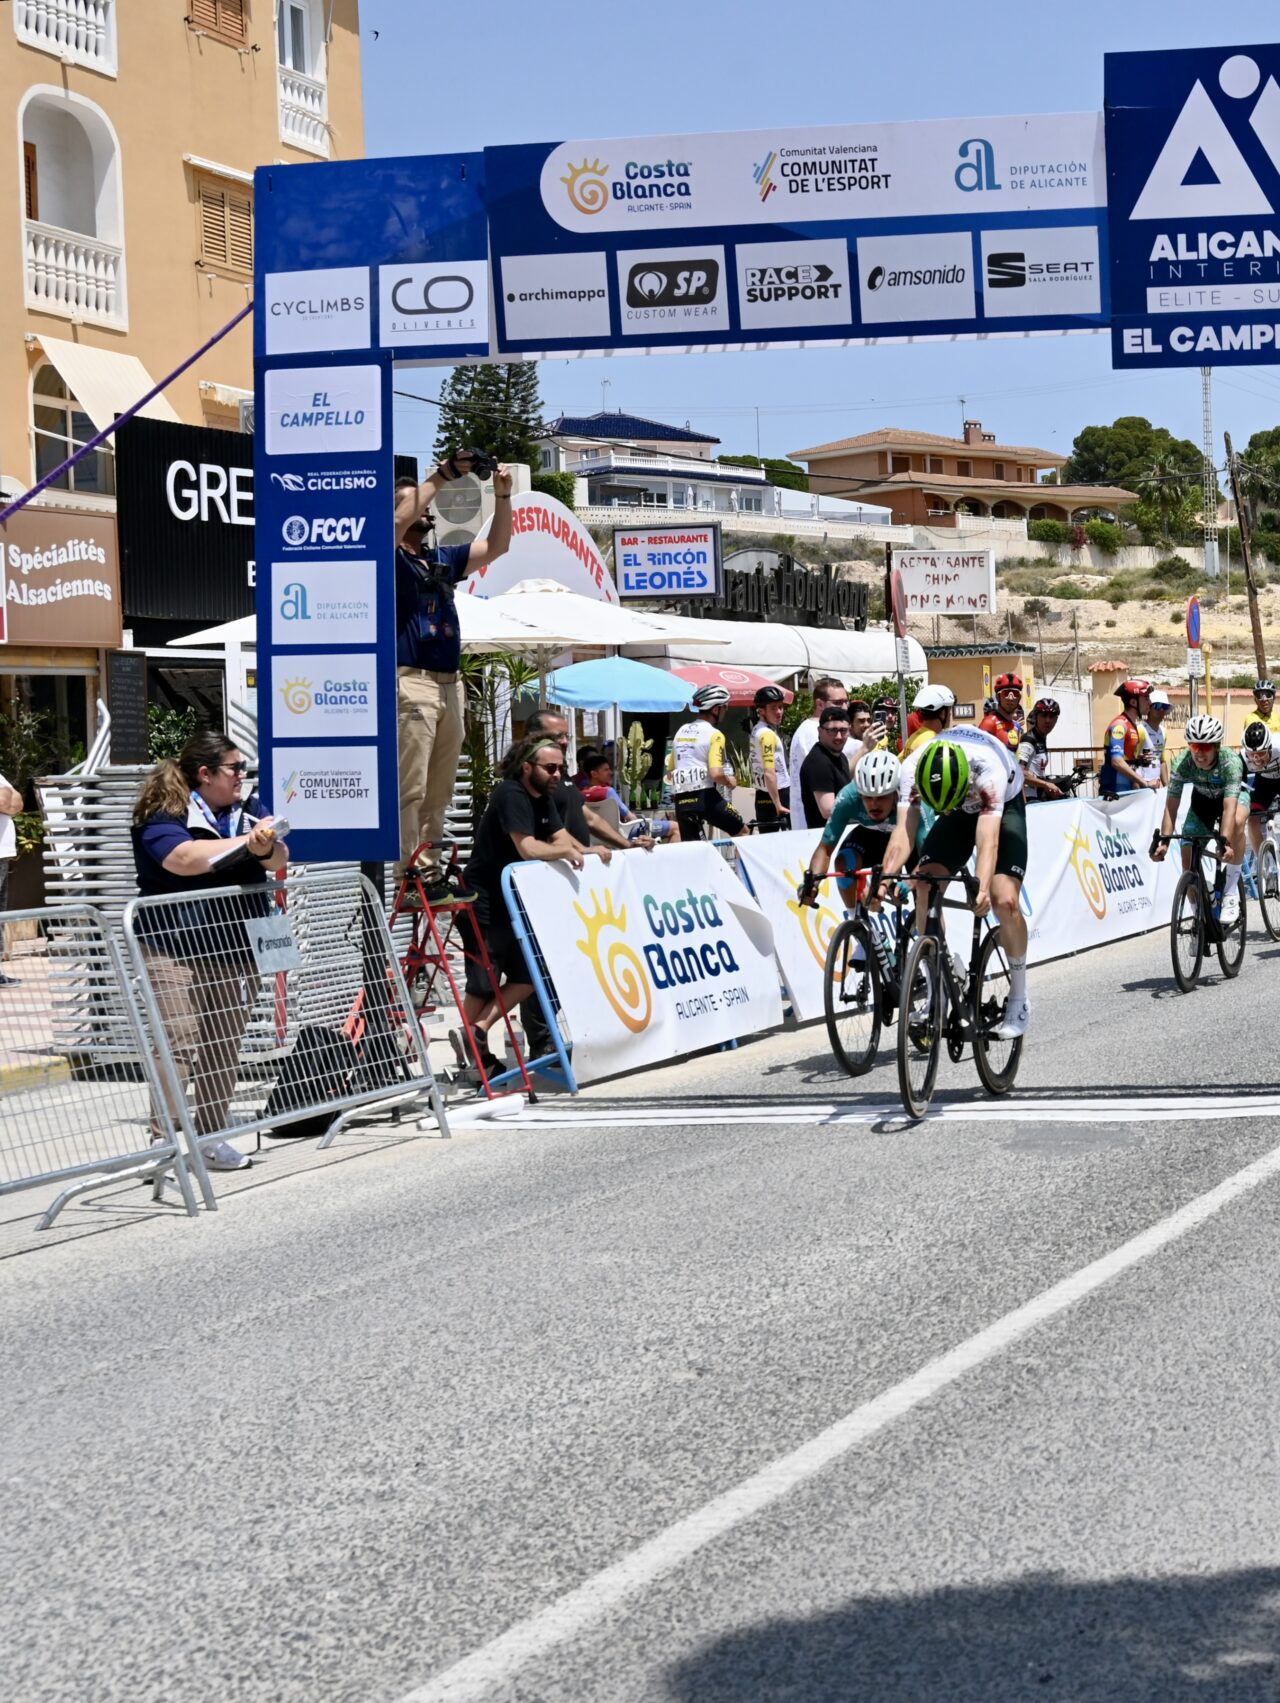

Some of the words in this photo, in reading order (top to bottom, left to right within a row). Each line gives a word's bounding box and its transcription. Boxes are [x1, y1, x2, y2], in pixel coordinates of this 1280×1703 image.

[780, 147, 826, 157] Comunitat
[828, 143, 878, 155] Valenciana
[625, 160, 690, 179] Costa
[780, 158, 878, 178] COMUNITAT
[1010, 161, 1088, 176] DIPUTACIÓN
[612, 180, 692, 200] Blanca
[788, 176, 811, 192] DE
[814, 173, 891, 191] L'ESPORT
[1010, 181, 1025, 190] DE
[1031, 177, 1088, 189] ALICANTE
[627, 204, 664, 213] ALICANTE
[667, 202, 692, 211] SPAIN
[745, 265, 813, 286] RACE
[887, 264, 966, 288] amsonido
[1028, 261, 1095, 275] SEAT
[519, 285, 606, 303] archimappa
[746, 284, 842, 303] SUPPORT
[1160, 291, 1223, 307] ELITE
[271, 297, 365, 316] CYCLIMBS
[626, 308, 678, 320] CUSTOM
[684, 306, 718, 317] WEAR
[392, 319, 475, 331] OLIVERES
[1123, 328, 1162, 354] EL
[312, 392, 331, 407] EL
[281, 411, 364, 427] CAMPELLO
[166, 459, 256, 526] GRE
[307, 476, 377, 491] CICLISMO
[311, 517, 366, 543] FCCV
[511, 506, 605, 590] RESTAURANTE
[621, 536, 638, 546] BAR
[648, 534, 709, 545] RESTAURANTE
[9, 538, 106, 575] Spécialités
[624, 553, 641, 567] EL
[624, 567, 708, 590] LEONÉS
[6, 577, 112, 606] Alsaciennes
[317, 601, 369, 610] DIPUTACIÓN
[324, 680, 368, 692] Costa
[315, 693, 368, 705] Blanca
[300, 778, 361, 788] COMUNITAT
[305, 790, 319, 799] DE
[321, 788, 370, 799] L'ESPORT
[1096, 828, 1136, 860] Costa
[1098, 863, 1144, 894] Blanca
[643, 888, 723, 938] Costa
[643, 940, 740, 989] Blanca
[675, 994, 718, 1020] ALICANTE
[723, 986, 750, 1007] SPAIN
